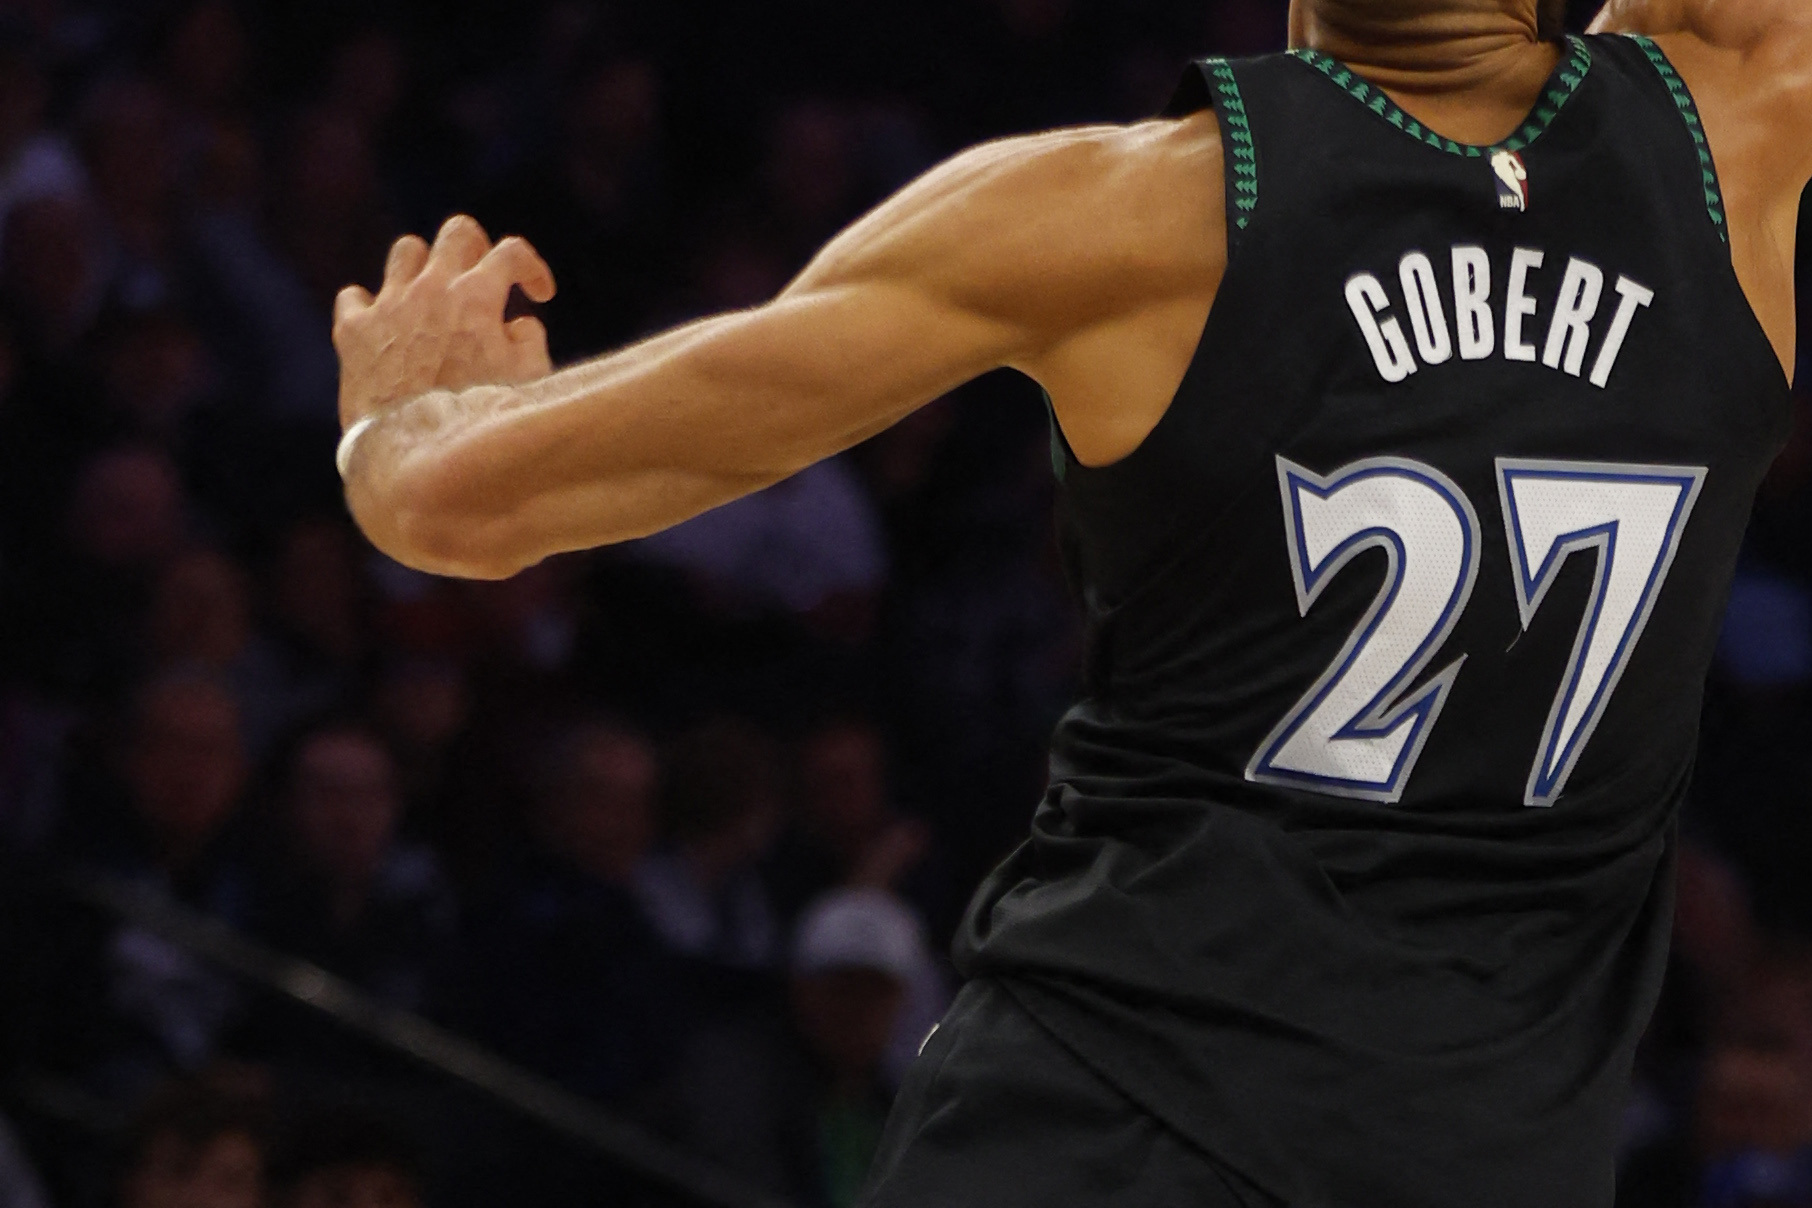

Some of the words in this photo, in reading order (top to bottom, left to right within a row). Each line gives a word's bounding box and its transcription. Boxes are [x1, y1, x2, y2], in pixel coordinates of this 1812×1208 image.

[1500, 194, 1520, 208] NBA
[1344, 245, 1655, 389] GOBERT
[1244, 453, 1710, 808] 27
